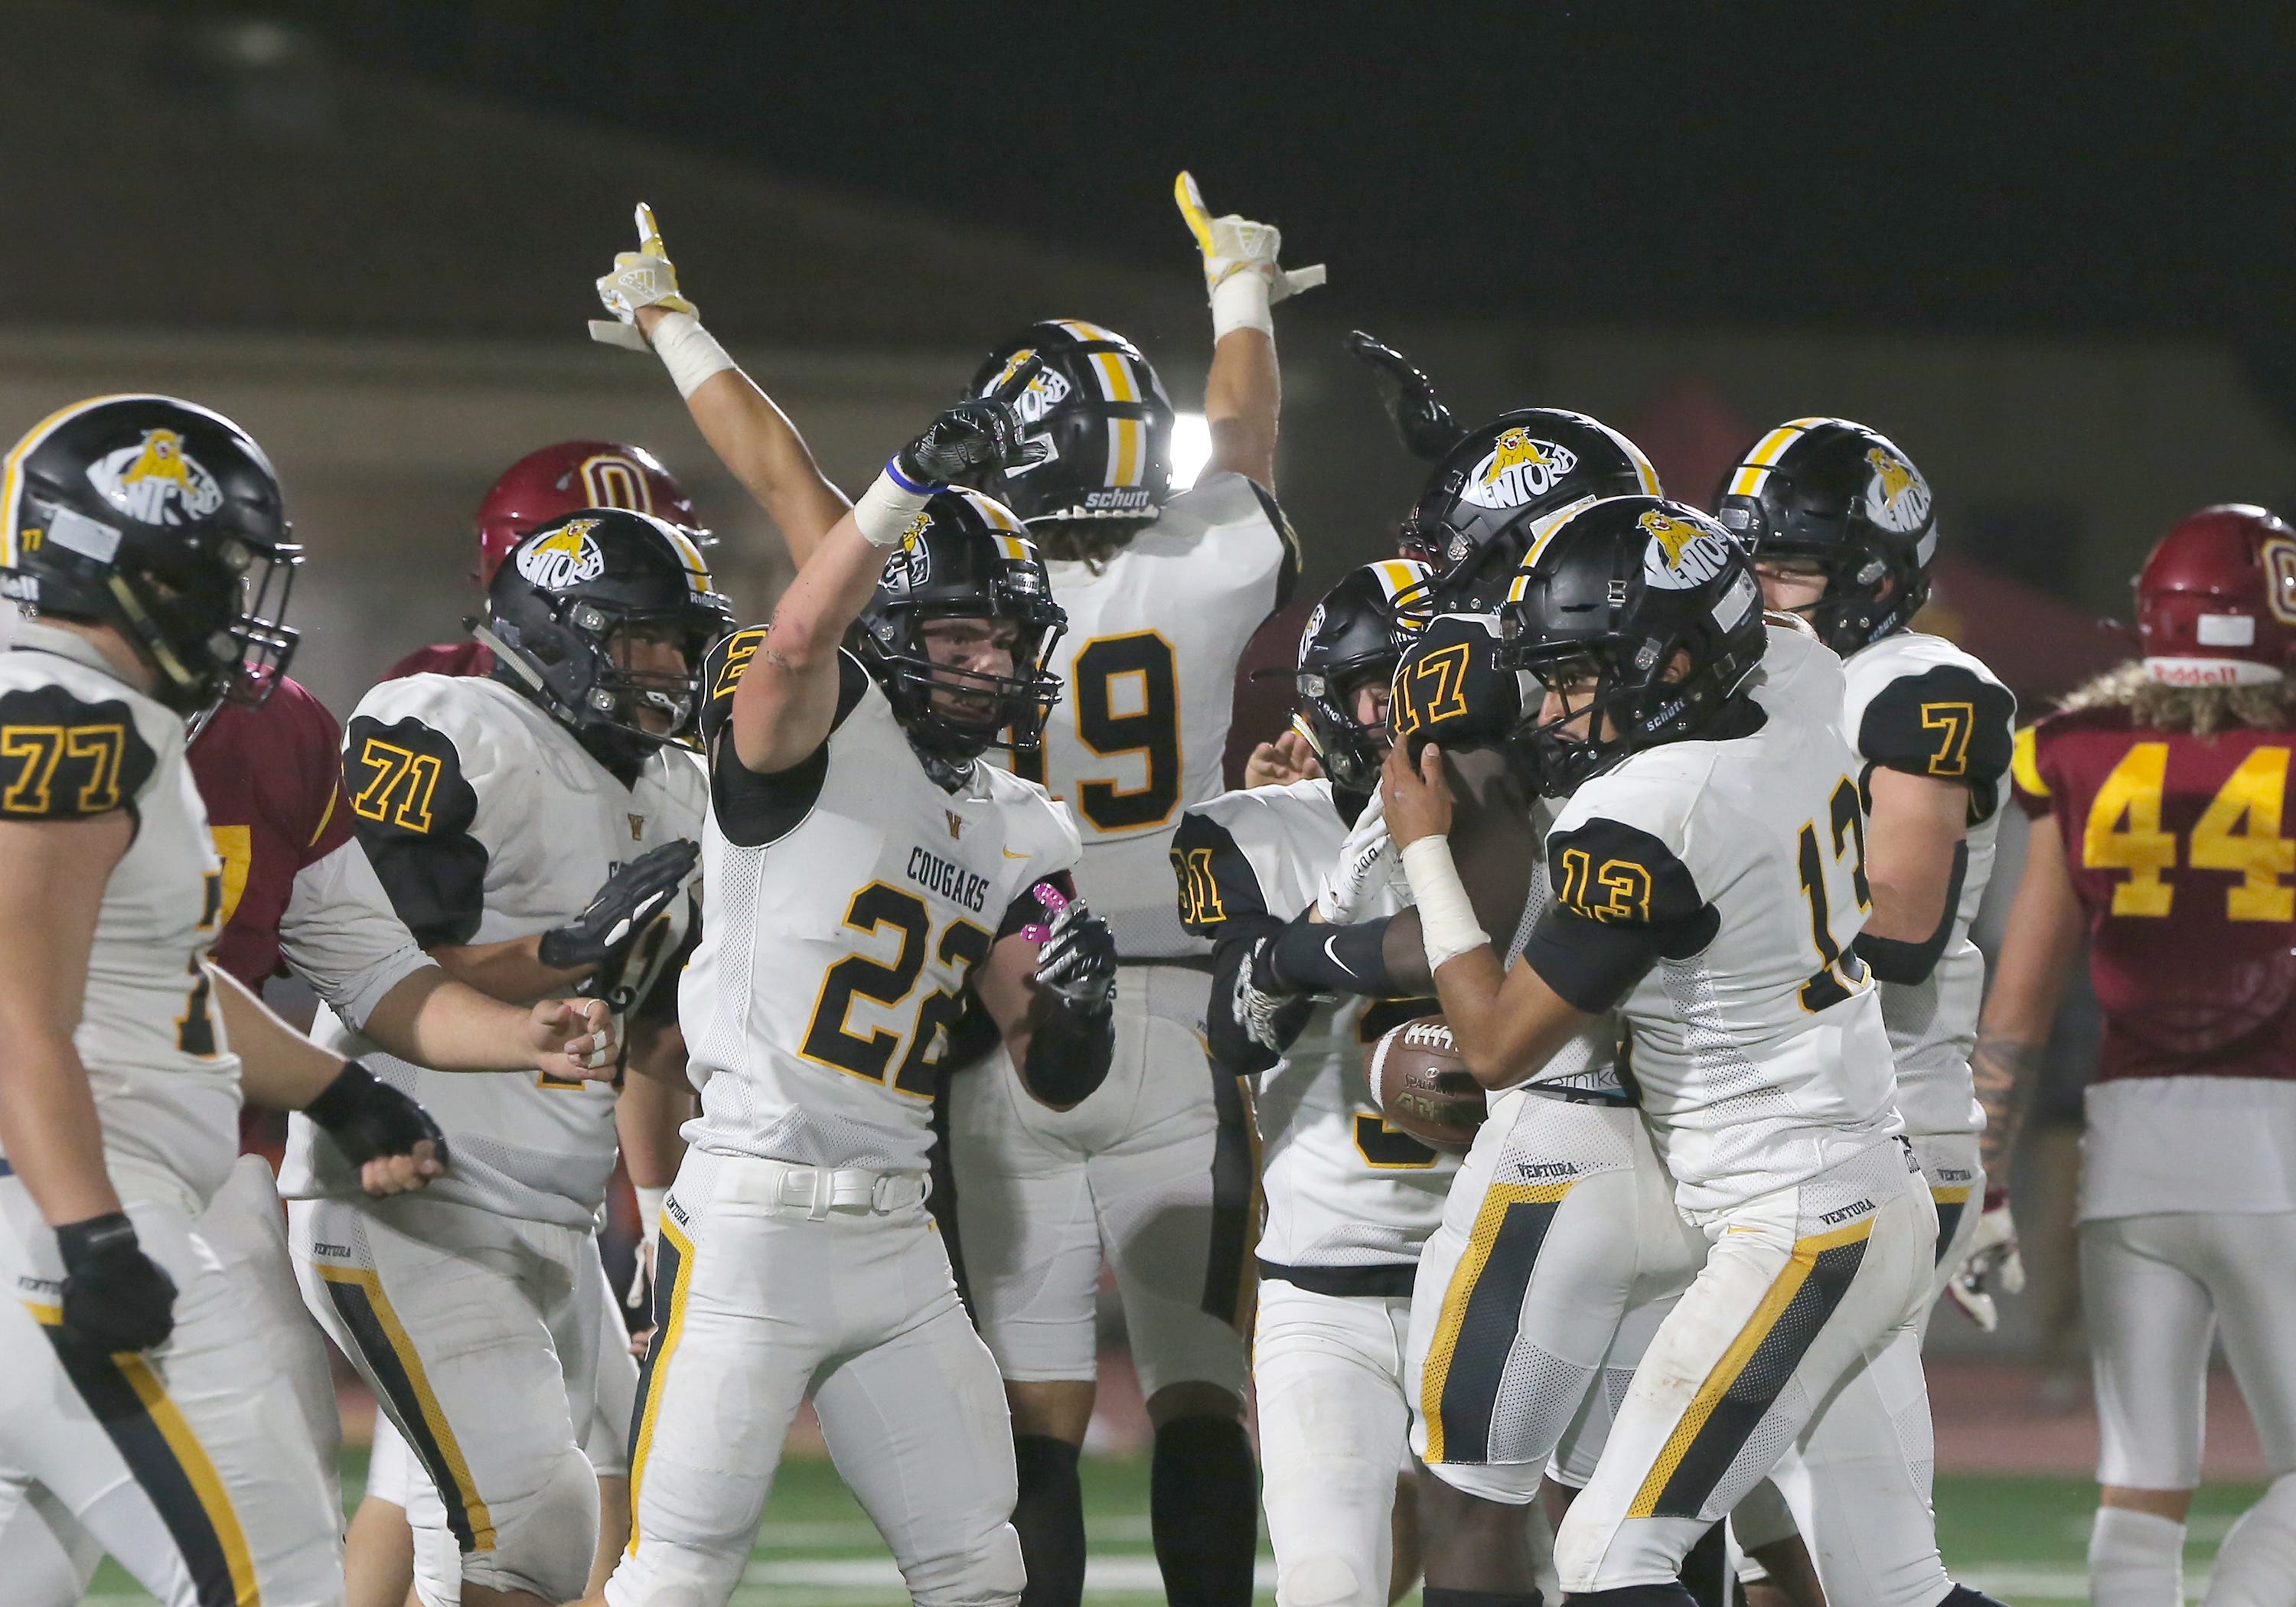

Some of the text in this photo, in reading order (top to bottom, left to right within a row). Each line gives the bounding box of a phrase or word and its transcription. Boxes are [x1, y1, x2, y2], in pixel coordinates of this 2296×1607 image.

[1085, 487, 1150, 507] schutt
[1459, 438, 1579, 509] VENTURA
[1394, 643, 1469, 736] 17
[2, 724, 125, 813] 77
[1921, 702, 1974, 775] 7
[354, 738, 442, 834] 71
[944, 808, 961, 840] V
[2082, 742, 2296, 923] 44
[907, 846, 990, 914] COUGARS
[1562, 847, 1652, 923] 13
[1518, 1162, 1579, 1178] VENTURA
[1818, 1198, 1876, 1225] VENTURA
